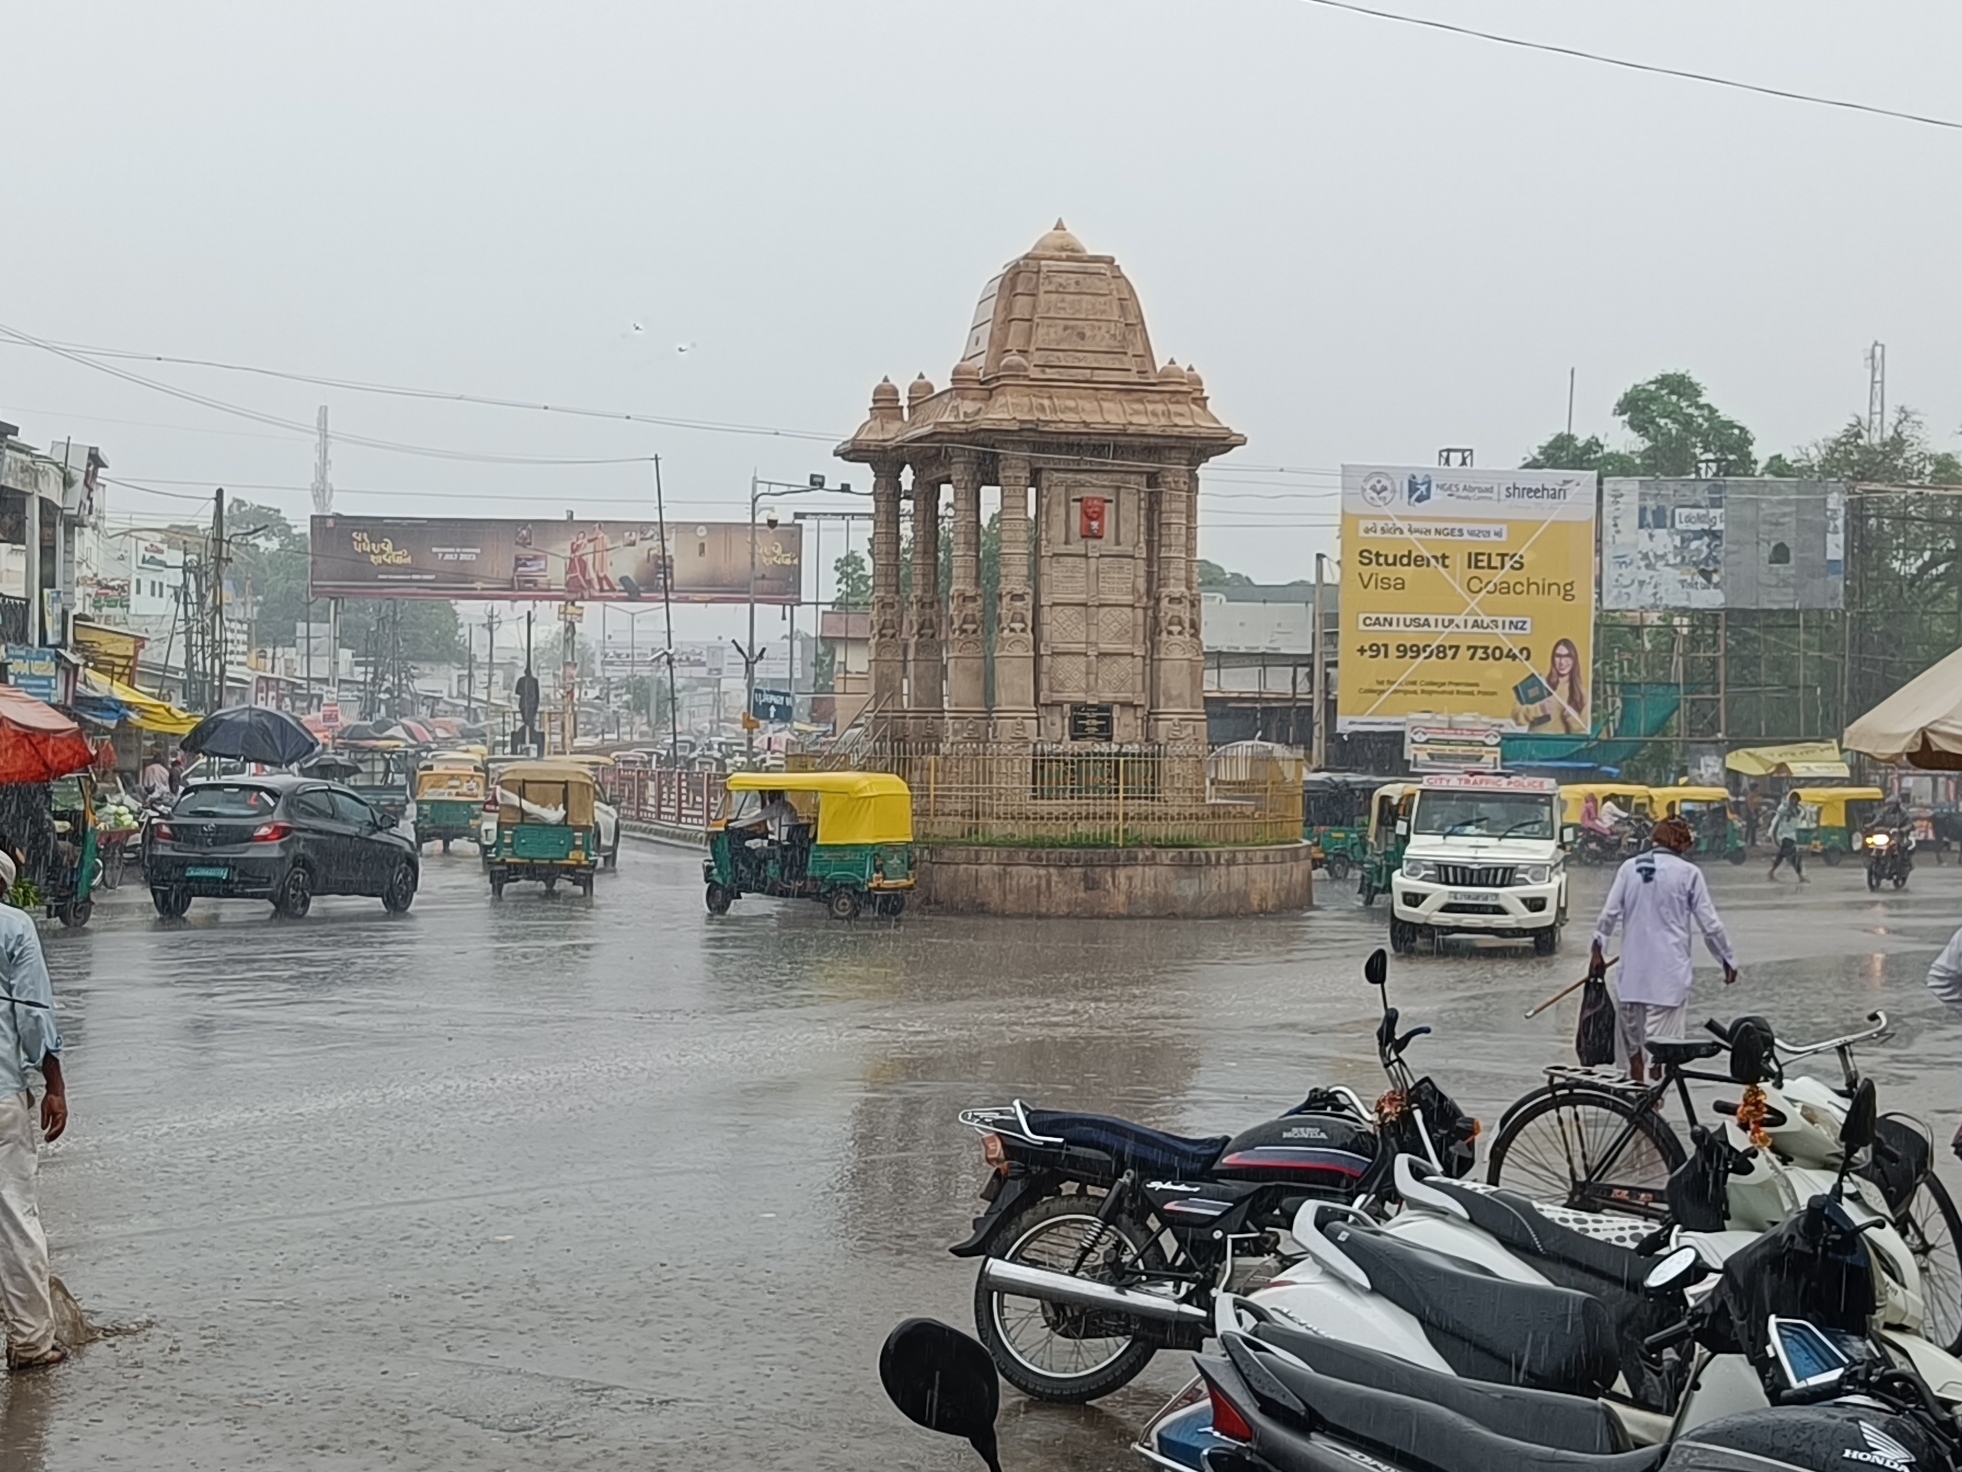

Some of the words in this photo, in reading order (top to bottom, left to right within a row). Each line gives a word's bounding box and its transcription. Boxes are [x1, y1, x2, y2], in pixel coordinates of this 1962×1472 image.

[1434, 528, 1464, 538] NGES
[1358, 549, 1450, 569] Student
[1467, 551, 1525, 571] IELTS
[1358, 572, 1406, 591] Visa
[1466, 575, 1576, 602] Coaching
[1362, 616, 1393, 628] CAN
[1403, 617, 1431, 629] USA
[1508, 619, 1528, 632] NZ
[1356, 643, 1390, 660] +91
[1395, 643, 1461, 661] 99987
[1466, 645, 1532, 663] 73040
[1426, 777, 1450, 786] CITY
[1458, 778, 1503, 788] TRAFFIC
[1506, 780, 1545, 789] POLICE
[1282, 1131, 1328, 1139] HONDA
[1842, 1449, 1911, 1472] HONDA
